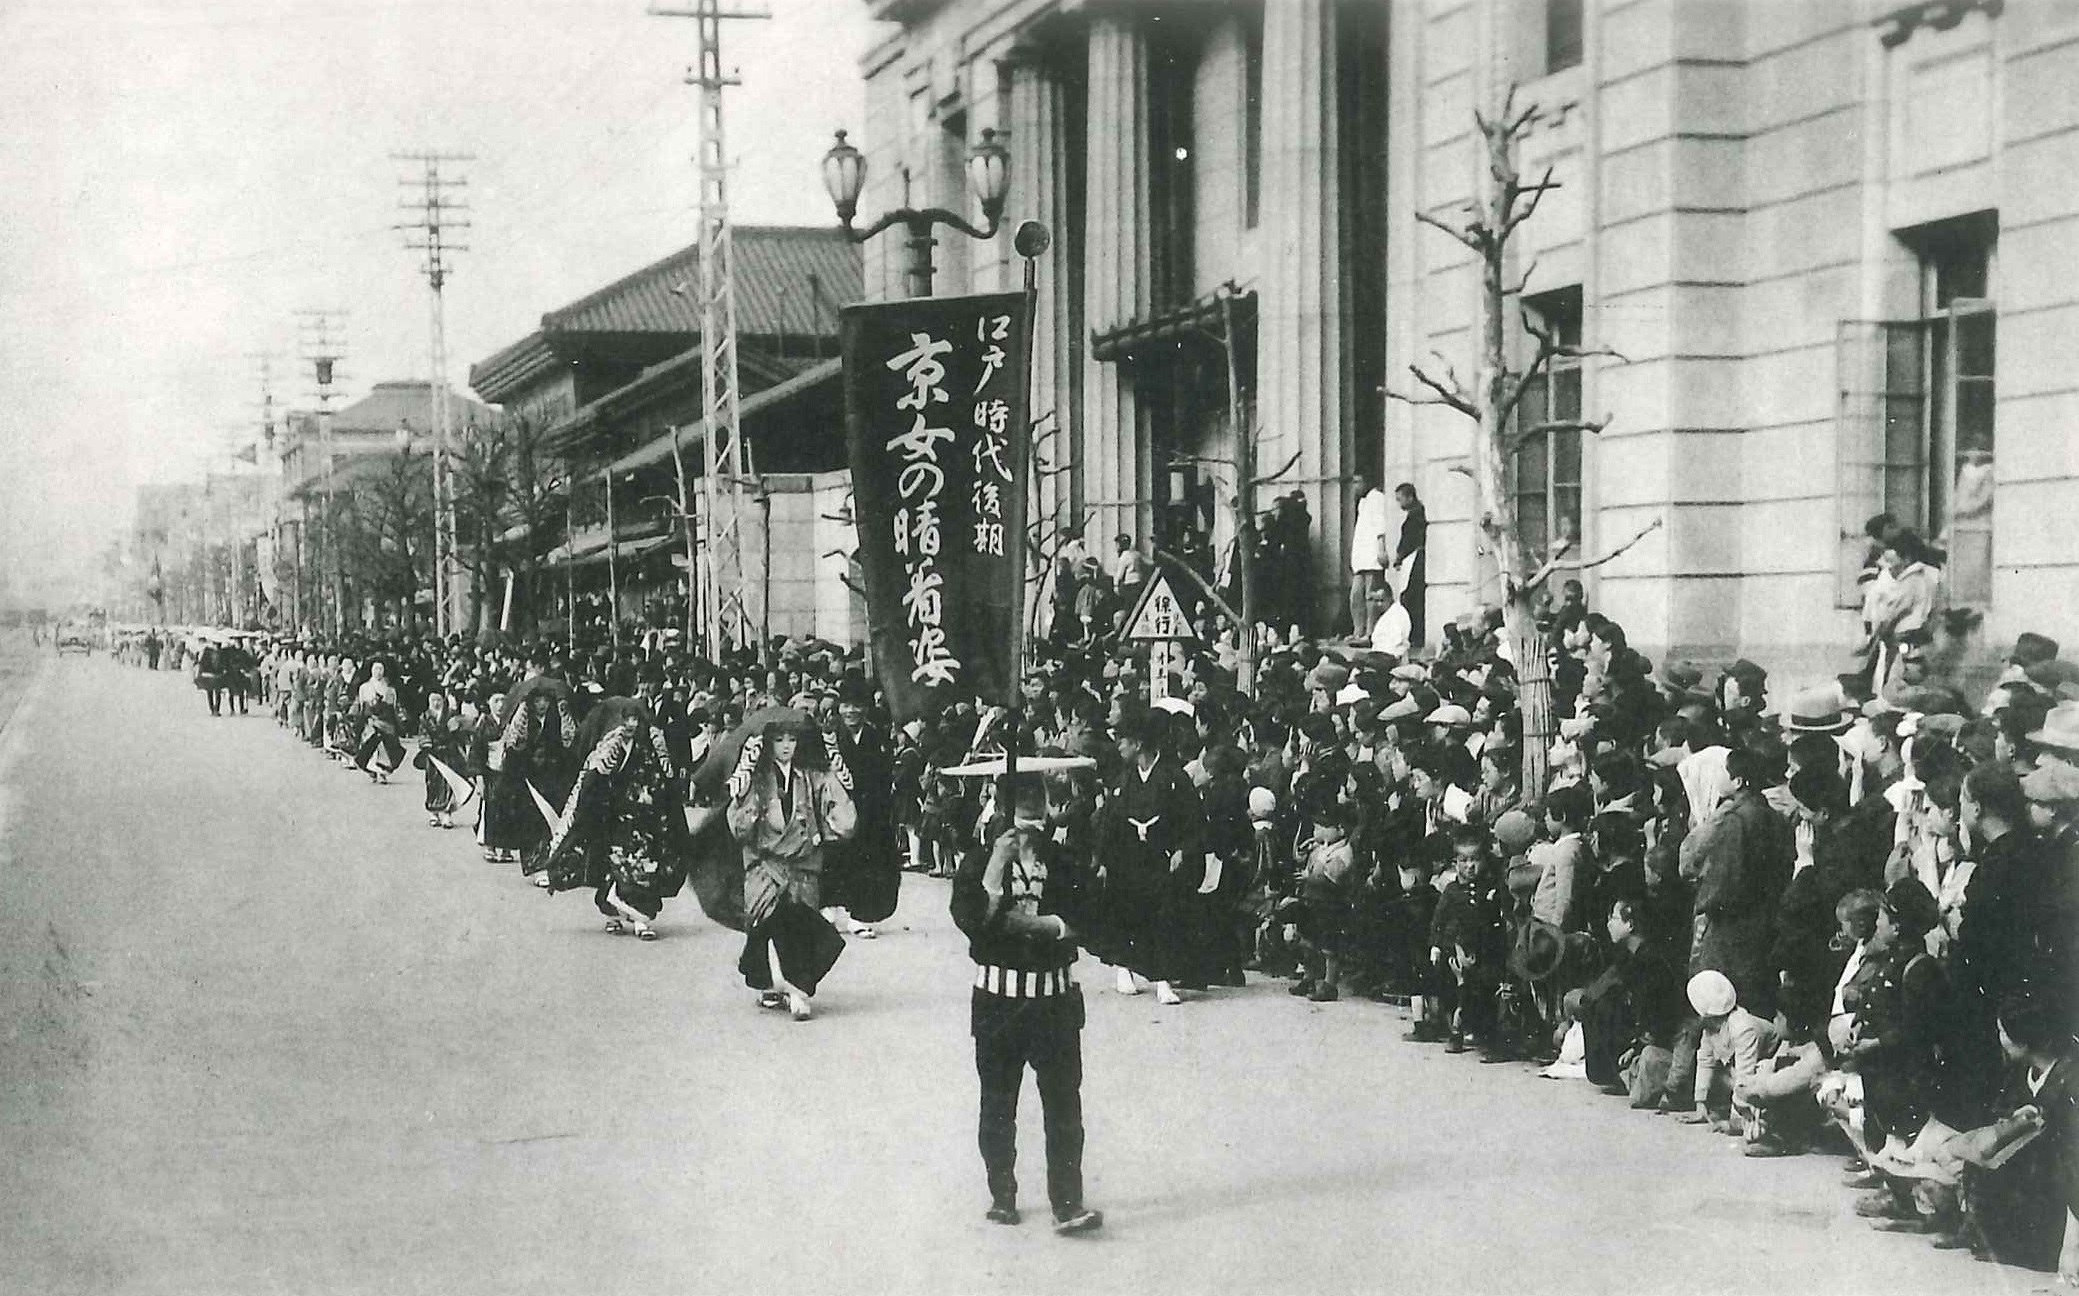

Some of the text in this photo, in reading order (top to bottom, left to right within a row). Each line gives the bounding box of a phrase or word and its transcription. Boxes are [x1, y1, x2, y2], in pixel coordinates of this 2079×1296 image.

[886, 333, 961, 688] 京女の晴着姿
